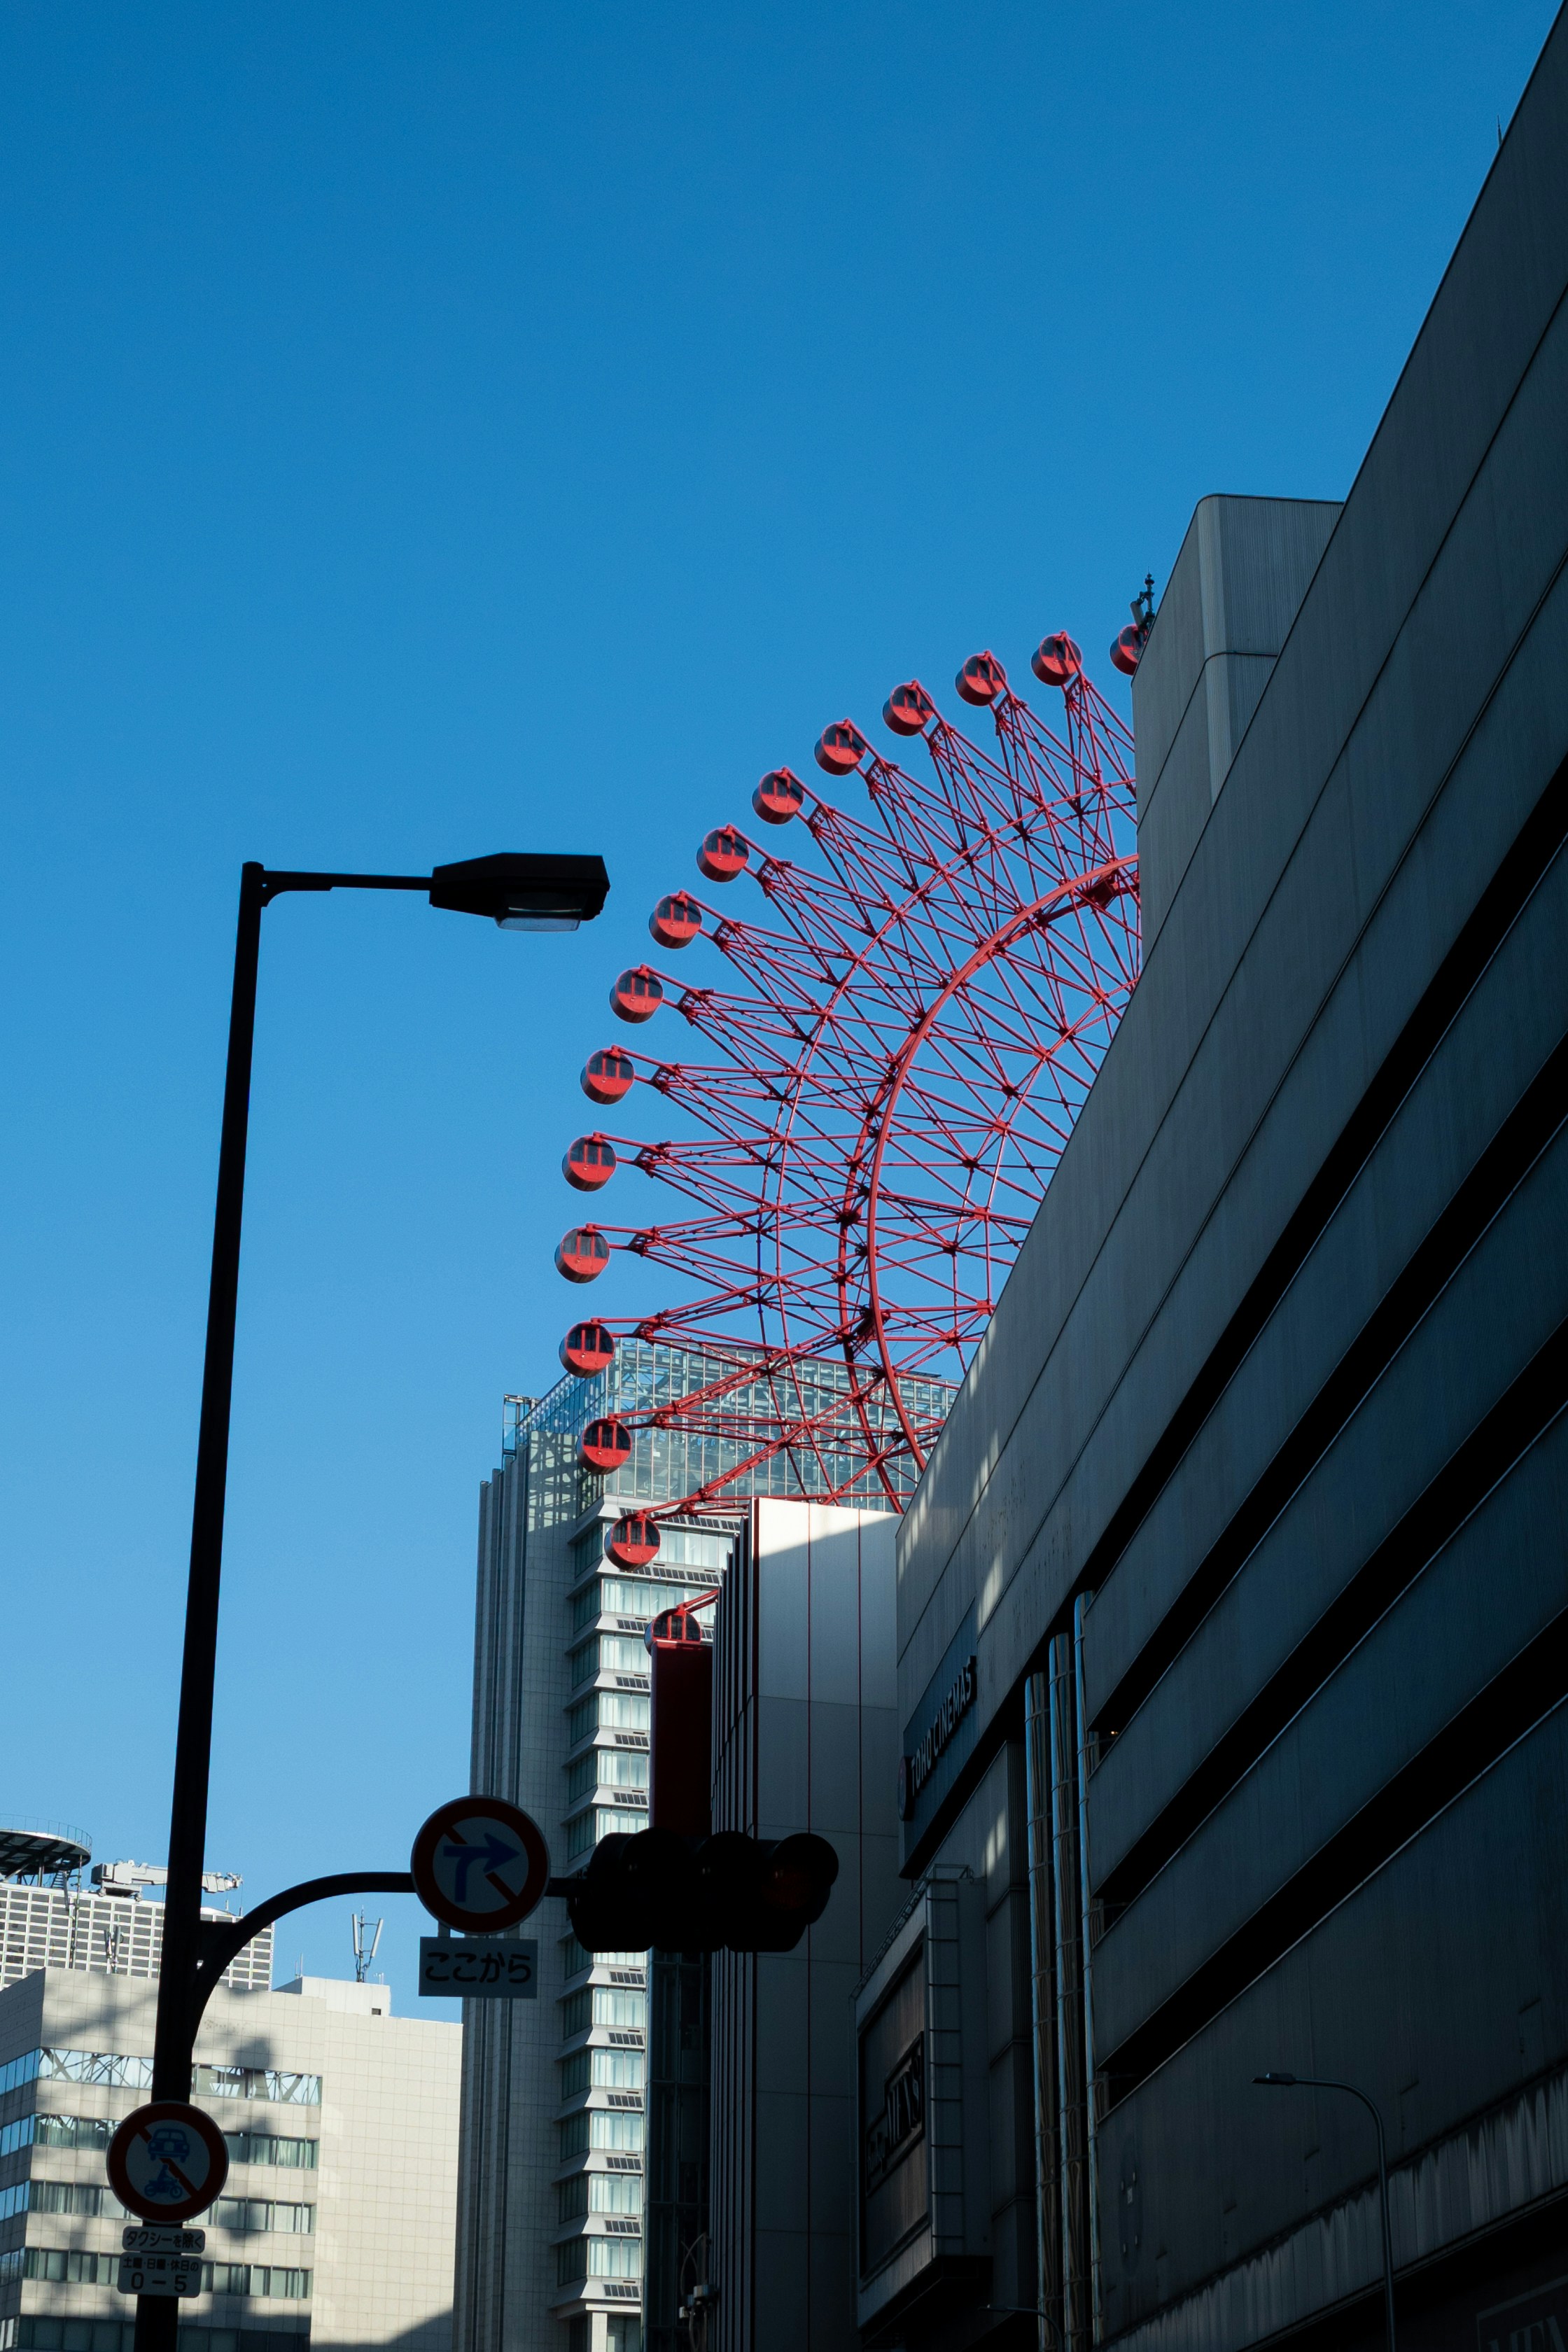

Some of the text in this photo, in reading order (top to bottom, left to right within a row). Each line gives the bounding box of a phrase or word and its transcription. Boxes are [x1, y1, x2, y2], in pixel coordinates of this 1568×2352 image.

[911, 1656, 974, 1797] TOHO CINEMAS
[426, 1952, 531, 1983] ここから
[127, 2231, 202, 2248] タクシーを除く
